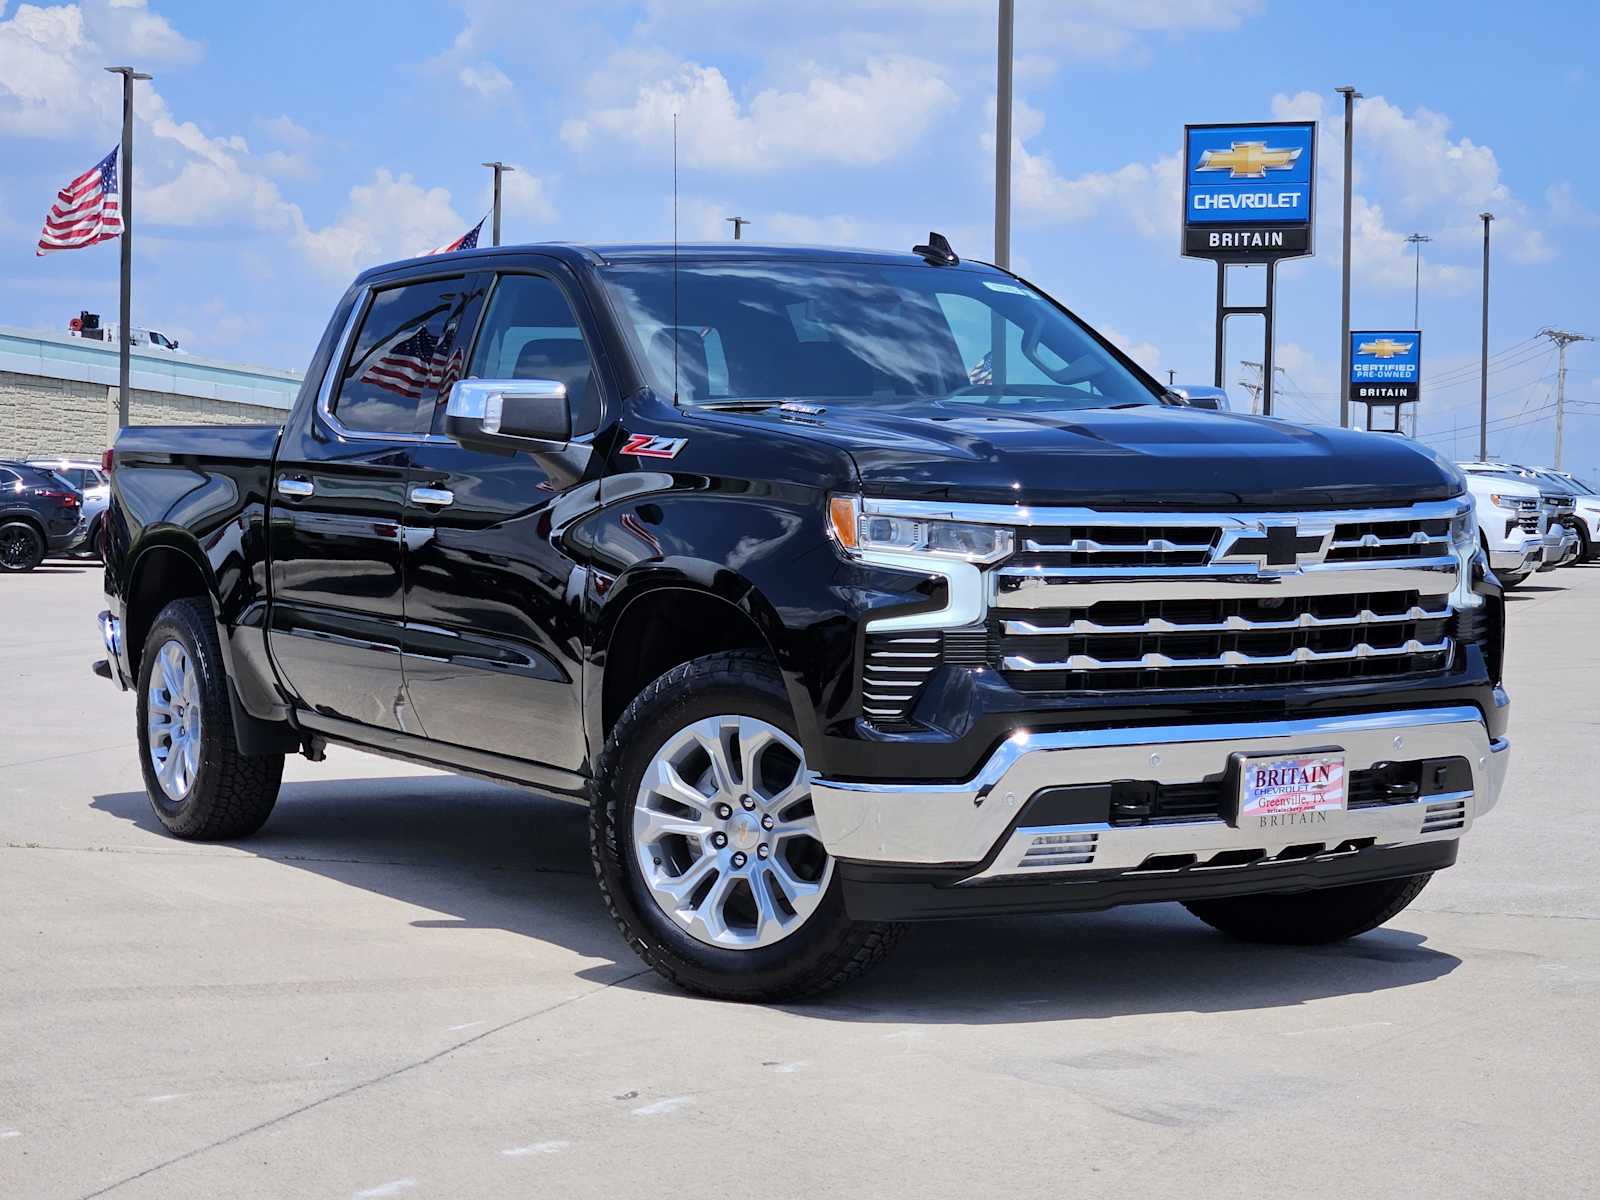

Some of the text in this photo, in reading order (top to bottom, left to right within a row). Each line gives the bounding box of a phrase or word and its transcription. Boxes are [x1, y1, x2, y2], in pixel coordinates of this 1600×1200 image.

[1193, 192, 1301, 209] CHEVROLET
[1208, 231, 1283, 247] BRITAIN
[1359, 388, 1408, 397] BRITAIN
[619, 433, 689, 459] Z71
[1255, 765, 1331, 788] BRITAIN
[1254, 784, 1309, 796] CHEVROLET
[1312, 792, 1326, 803] TX
[1259, 811, 1328, 828] BRITAIN
